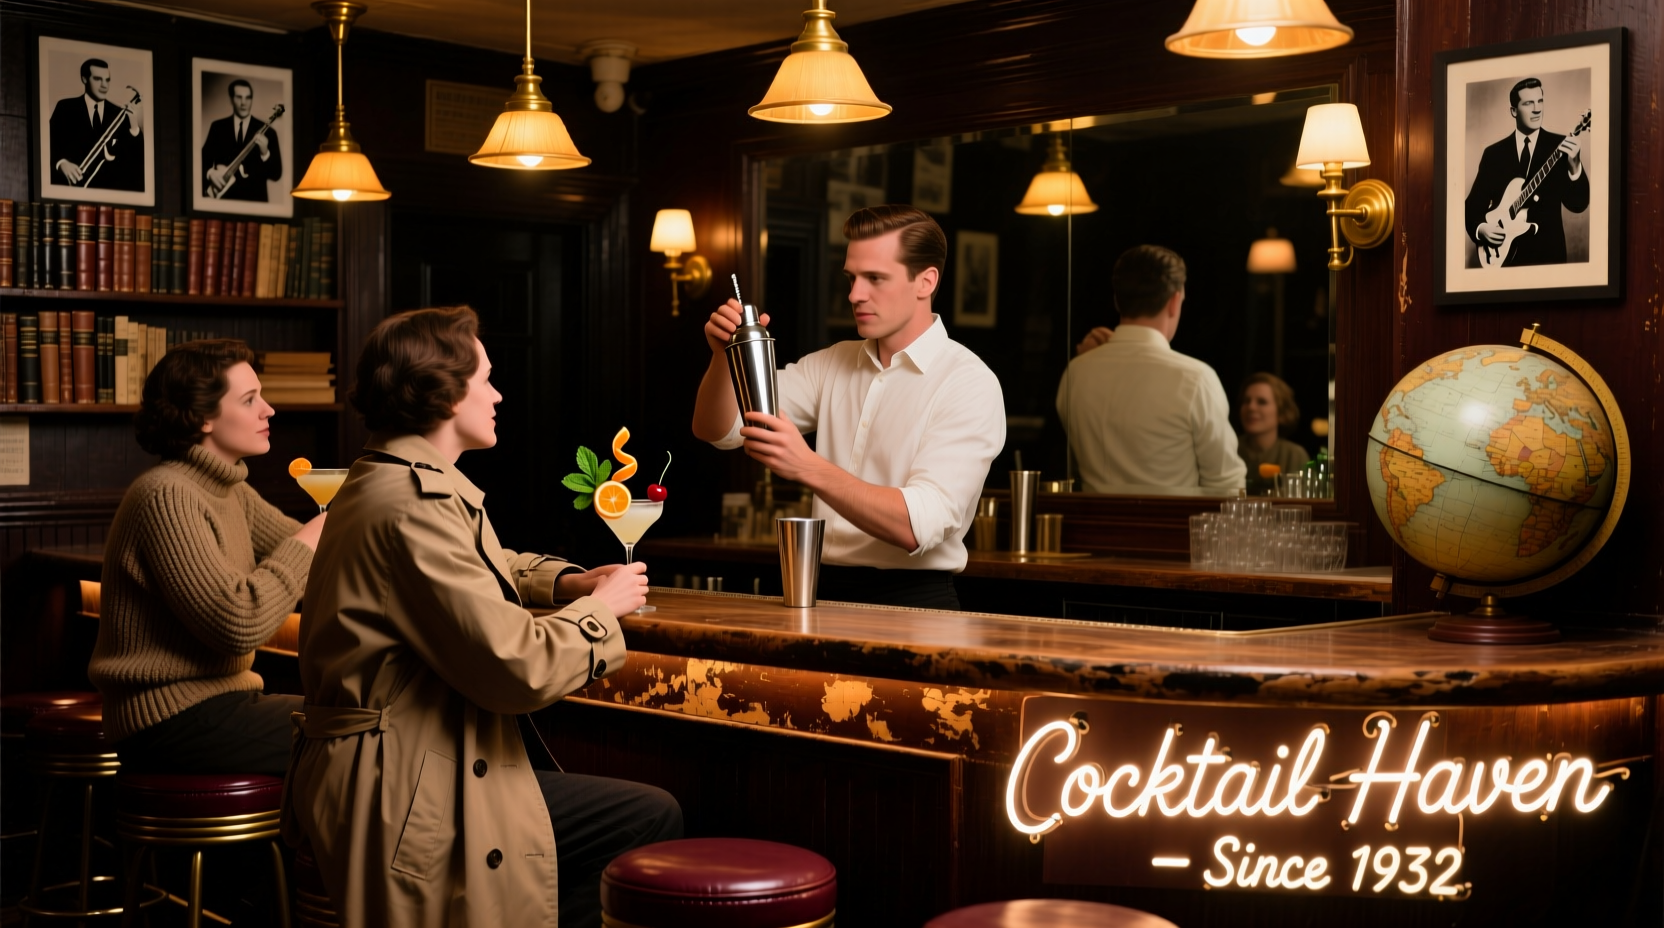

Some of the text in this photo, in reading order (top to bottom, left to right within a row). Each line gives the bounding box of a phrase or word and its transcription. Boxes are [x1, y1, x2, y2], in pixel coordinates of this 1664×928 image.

[1005, 718, 1612, 836] Cocktail Haven
[1203, 835, 1331, 891] Since
[1352, 844, 1463, 897] 1932
